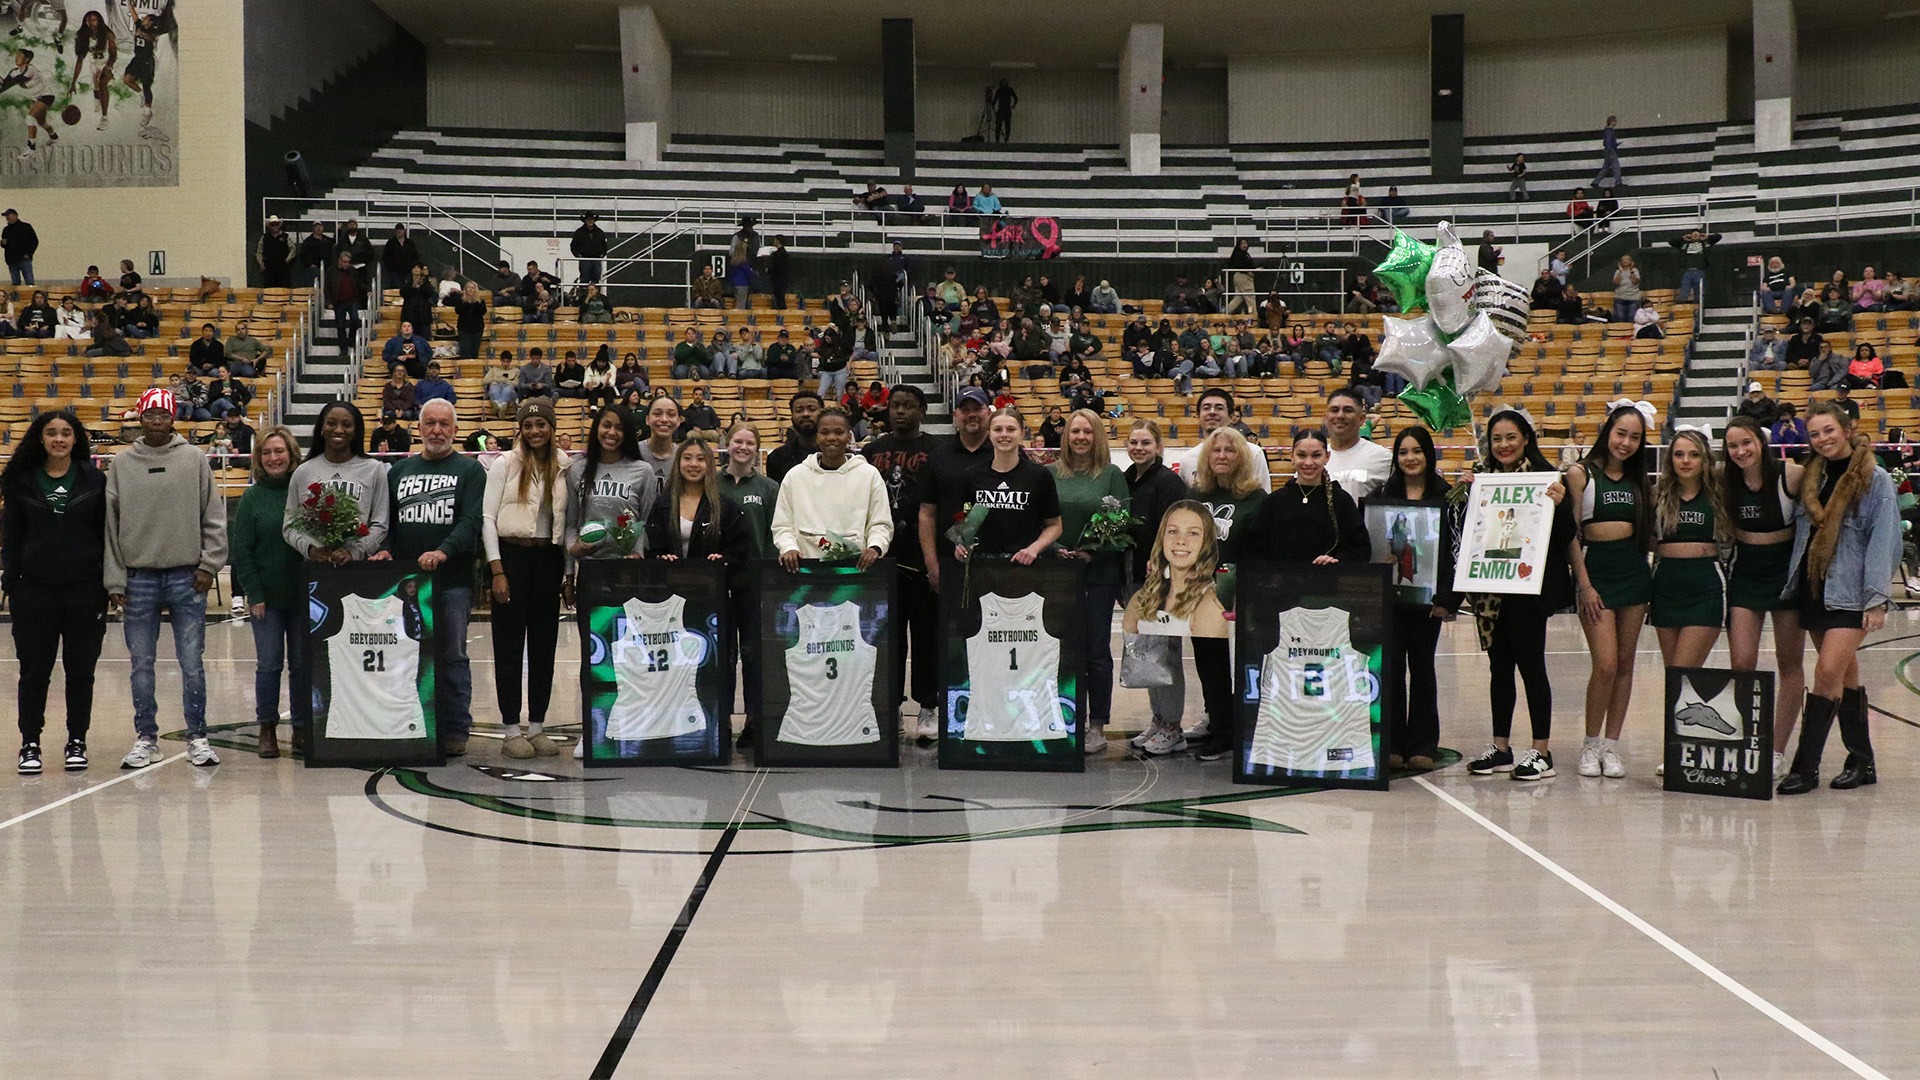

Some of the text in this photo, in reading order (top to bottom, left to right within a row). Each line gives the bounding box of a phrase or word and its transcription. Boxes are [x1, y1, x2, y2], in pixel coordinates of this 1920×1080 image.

[0, 144, 172, 176] REYHOUNDS
[153, 251, 162, 275] A
[715, 256, 724, 278] B
[1293, 263, 1301, 283] C
[397, 474, 458, 500] EASTERN
[578, 479, 632, 502] NMU
[1490, 486, 1537, 504] ALEX
[743, 494, 763, 506] ENMU
[975, 490, 1031, 505] ENMU
[977, 502, 1025, 511] ASKETBALL
[1603, 490, 1634, 505] ENMU
[399, 498, 456, 525] HOUNDS
[1679, 510, 1705, 526] NMU
[1468, 561, 1518, 580] ENMU
[349, 632, 398, 646] GREYHOUNDS
[632, 630, 679, 647] GREYHOUNDS
[987, 630, 1039, 643] GREYHOUNDS
[806, 639, 855, 655] GREYHOUNDS
[363, 649, 386, 672] 21
[647, 649, 670, 673] 12
[825, 657, 838, 680] 3
[1009, 647, 1019, 670] 1
[1750, 679, 1762, 750] ANNIE
[1680, 742, 1761, 775] ENMU
[1683, 768, 1728, 787] Cheer
